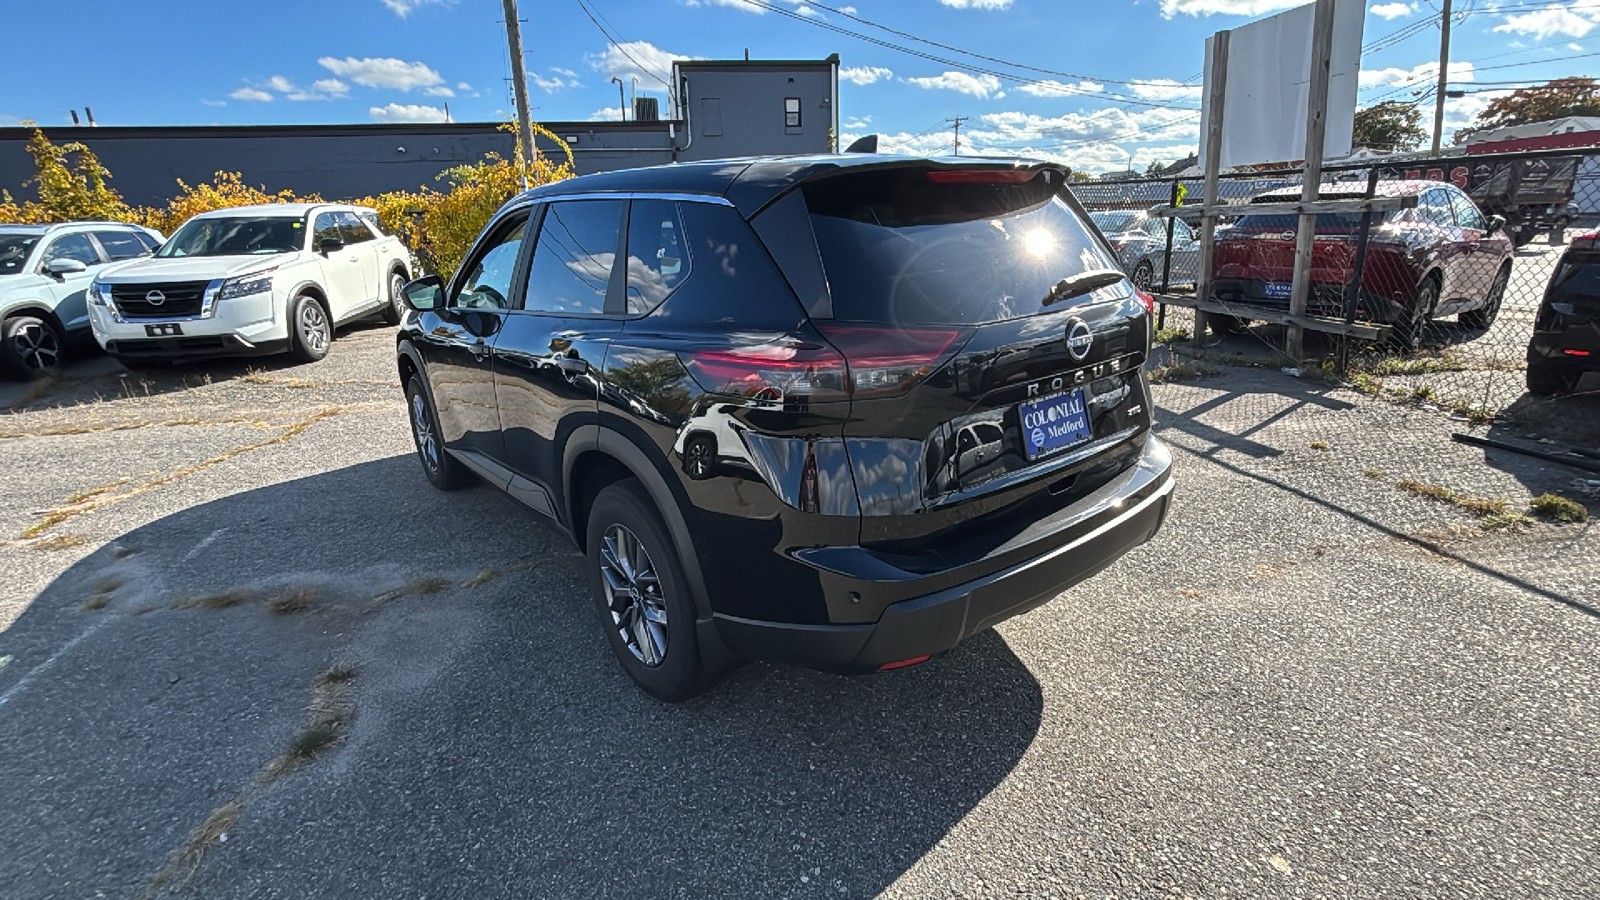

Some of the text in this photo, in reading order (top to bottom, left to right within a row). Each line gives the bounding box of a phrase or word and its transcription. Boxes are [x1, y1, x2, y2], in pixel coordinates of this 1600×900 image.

[1027, 359, 1120, 397] ROGUE
[1024, 398, 1084, 429] COLONIAL
[1047, 416, 1085, 439] Medford
